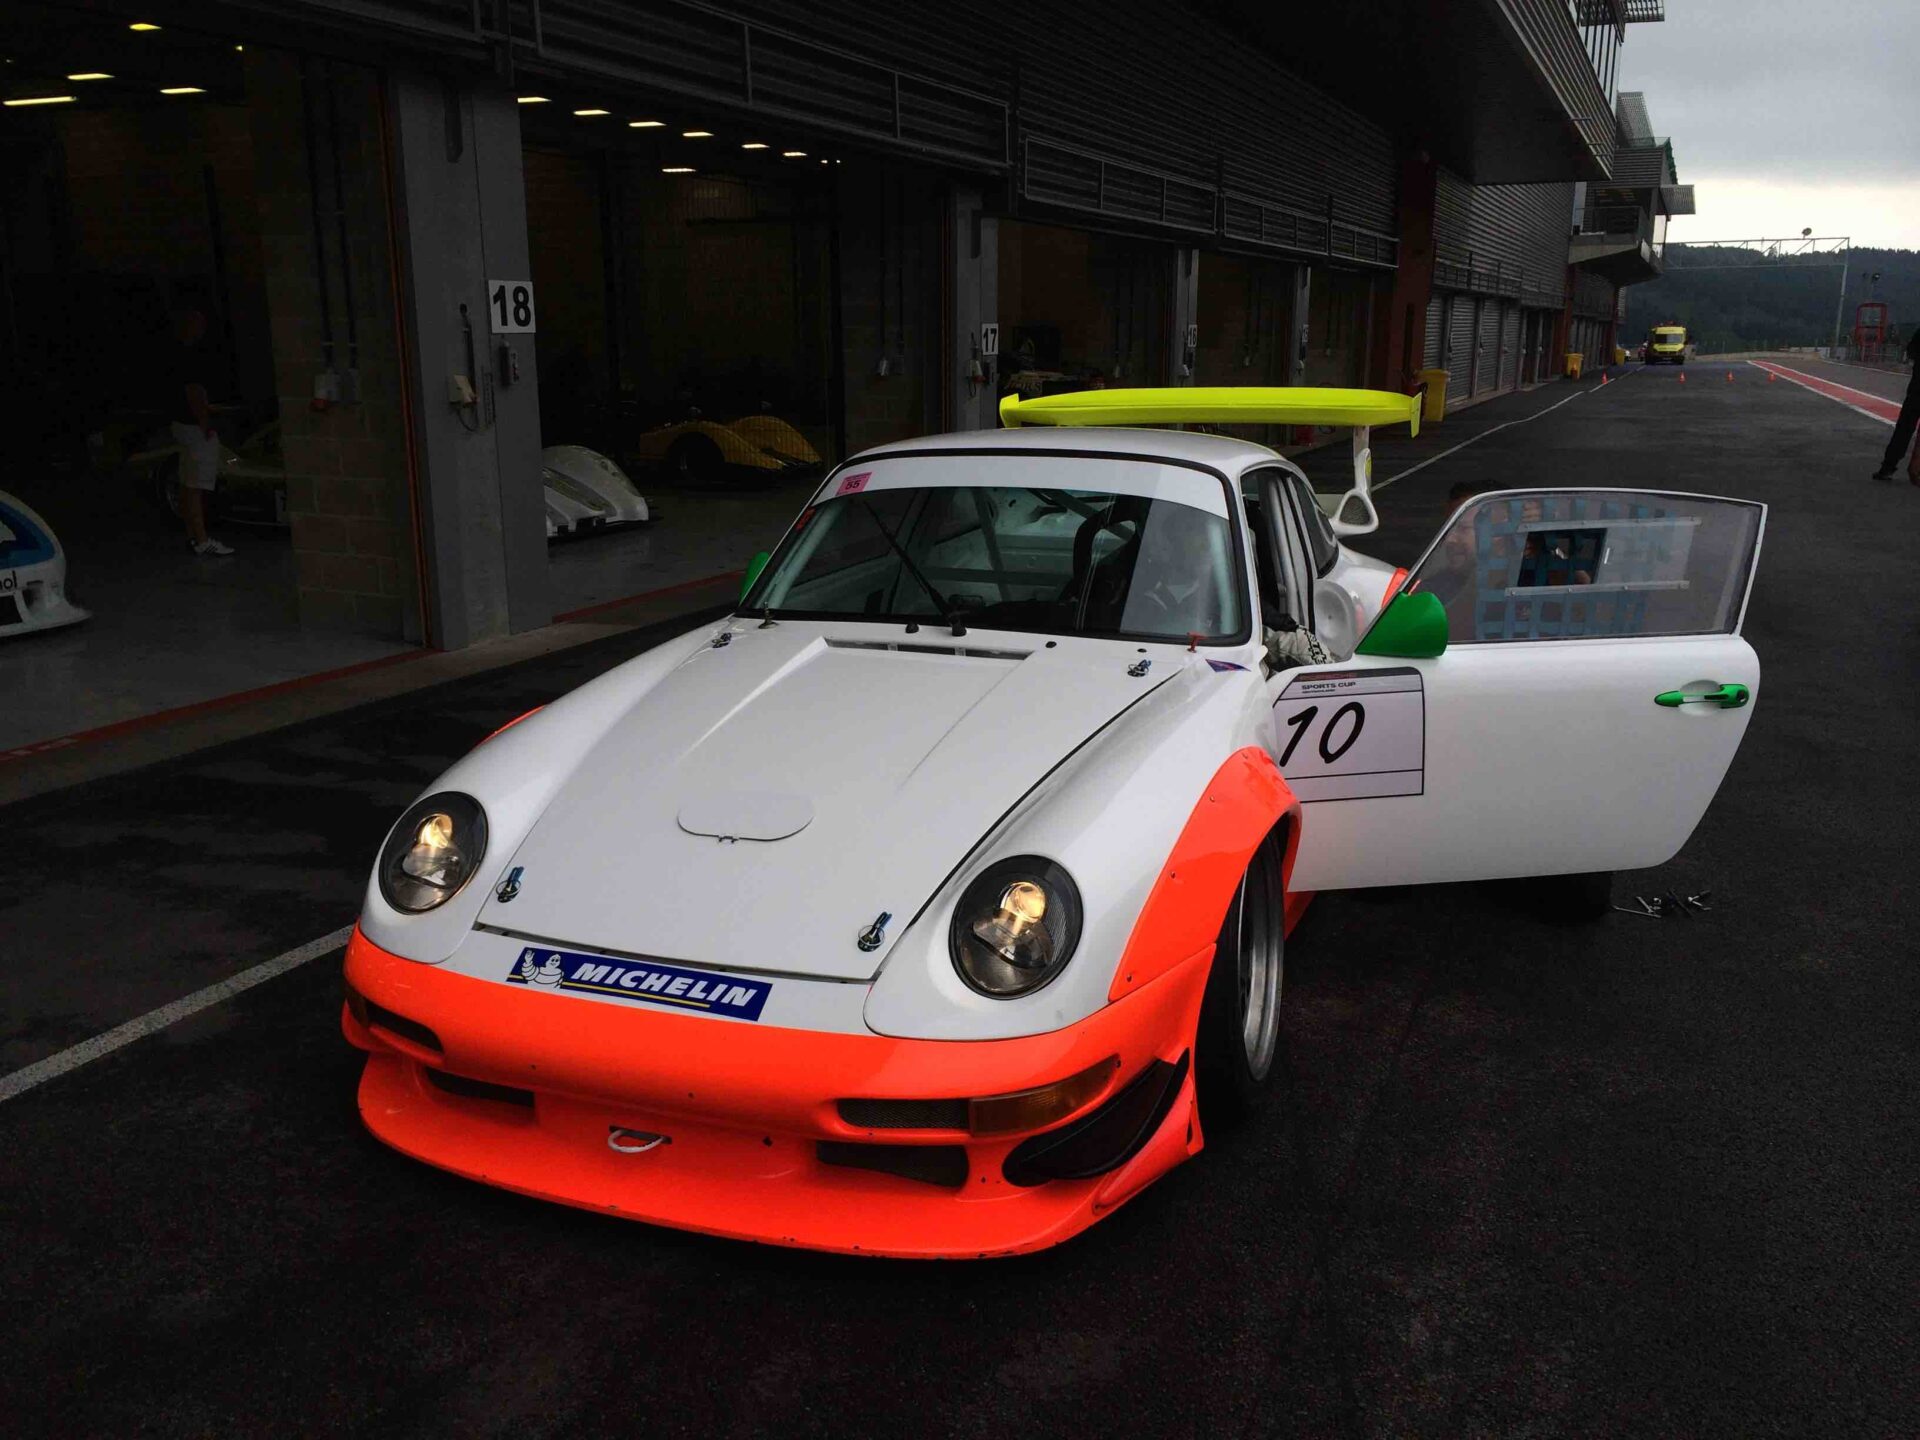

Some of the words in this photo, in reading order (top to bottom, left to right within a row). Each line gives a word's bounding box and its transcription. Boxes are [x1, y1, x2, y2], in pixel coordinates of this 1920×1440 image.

[493, 284, 531, 327] 18
[983, 327, 997, 352] 17
[1279, 701, 1366, 767] 10
[570, 962, 757, 1007] MICHELIN
